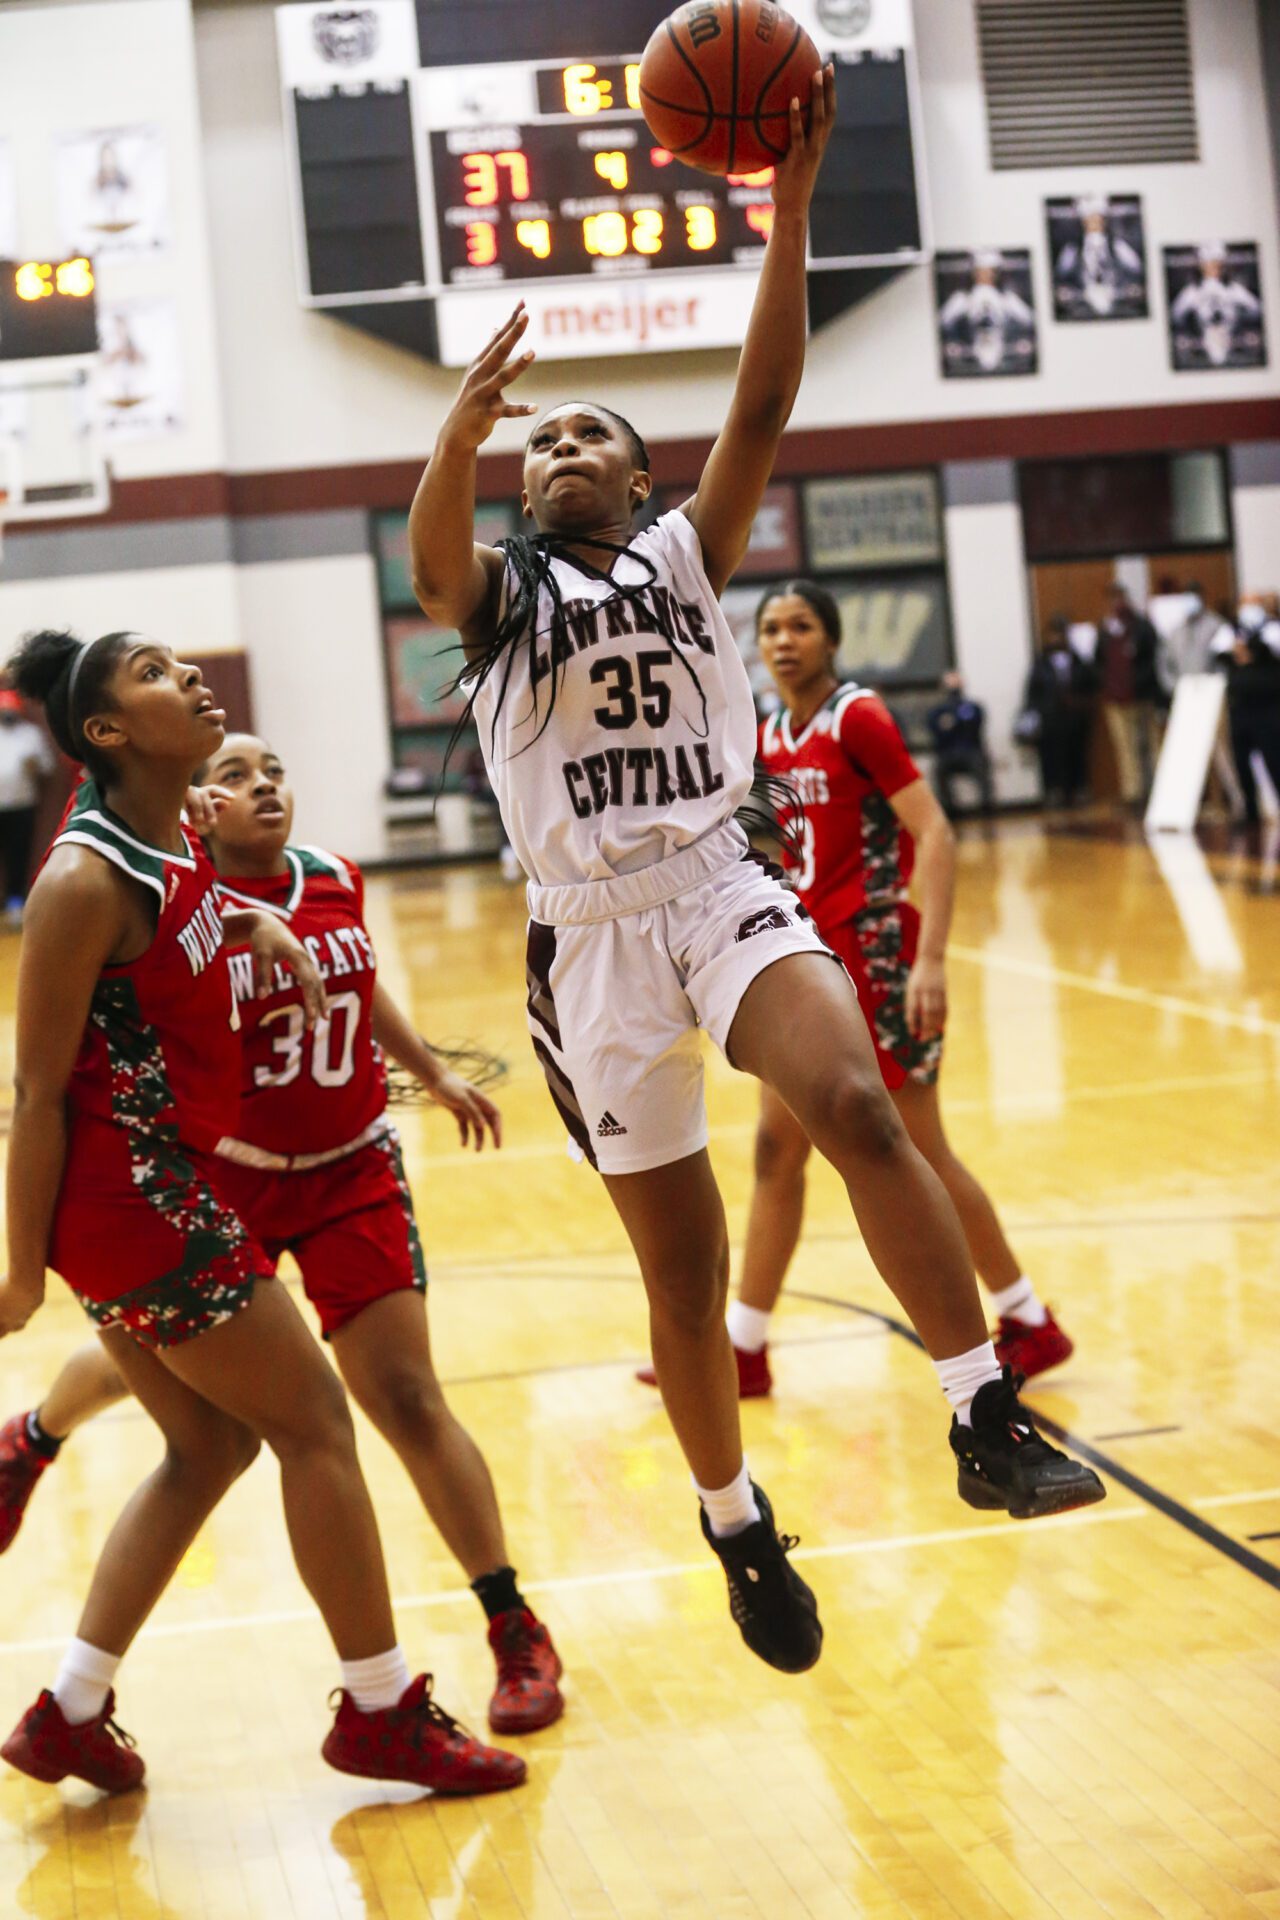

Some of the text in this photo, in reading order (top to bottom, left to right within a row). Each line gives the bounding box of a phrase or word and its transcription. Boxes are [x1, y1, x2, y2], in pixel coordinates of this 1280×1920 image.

[563, 64, 641, 116] 6:1
[462, 152, 530, 206] 37
[465, 221, 497, 267] 3
[543, 292, 702, 341] meijer
[588, 650, 673, 730] 35
[562, 743, 724, 819] CENTRAL
[227, 925, 377, 1002] WLCATS
[254, 990, 361, 1088] 30
[596, 1126, 628, 1137] adidas
